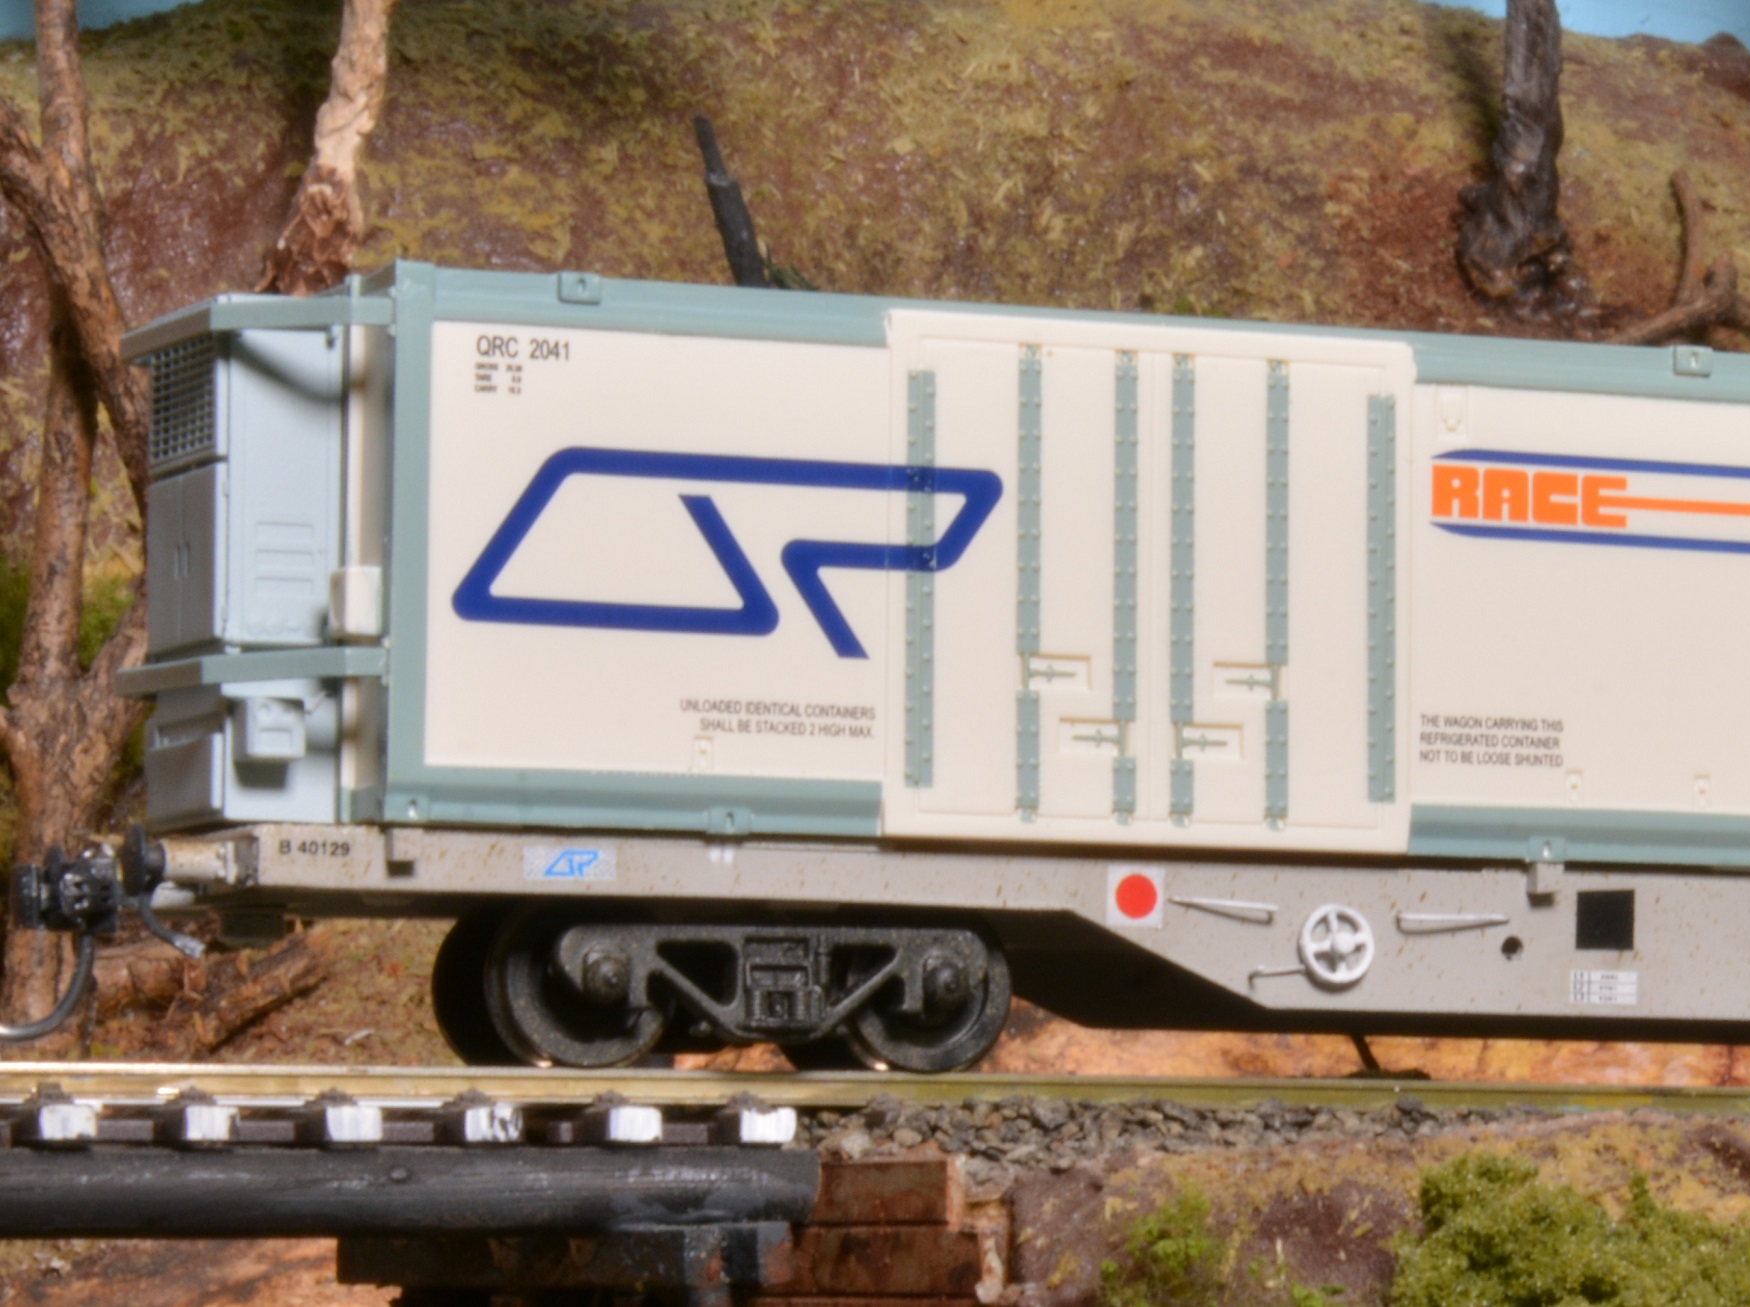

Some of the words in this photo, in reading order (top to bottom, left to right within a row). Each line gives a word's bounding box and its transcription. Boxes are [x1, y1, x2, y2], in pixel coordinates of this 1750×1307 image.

[476, 335, 519, 358] QRC
[529, 338, 569, 361] 2041
[1432, 464, 1627, 528] RACE
[680, 699, 742, 714] UNLOADED
[745, 701, 800, 717] IDENTICAL
[805, 704, 876, 720] CONTAINERS
[700, 717, 735, 733] SHALL
[737, 719, 751, 733] BE
[755, 719, 806, 736] STACKED
[809, 722, 815, 736] 2
[818, 722, 846, 737] HIGH
[849, 725, 875, 739] MAX.
[1421, 714, 1440, 727] THE
[1443, 715, 1482, 729] WAGON
[1485, 717, 1538, 731] CARRYING
[1541, 719, 1564, 733] THIS
[1420, 732, 1499, 748] REFRIGERATED
[1501, 735, 1560, 749] CONTAINER
[1420, 750, 1441, 763] NOT
[1445, 751, 1458, 763] TO
[1460, 751, 1473, 764] BE
[1477, 752, 1511, 766] LOOSE
[1514, 753, 1563, 767] SHUNTED
[279, 839, 291, 855] B
[297, 840, 350, 857] 40129
